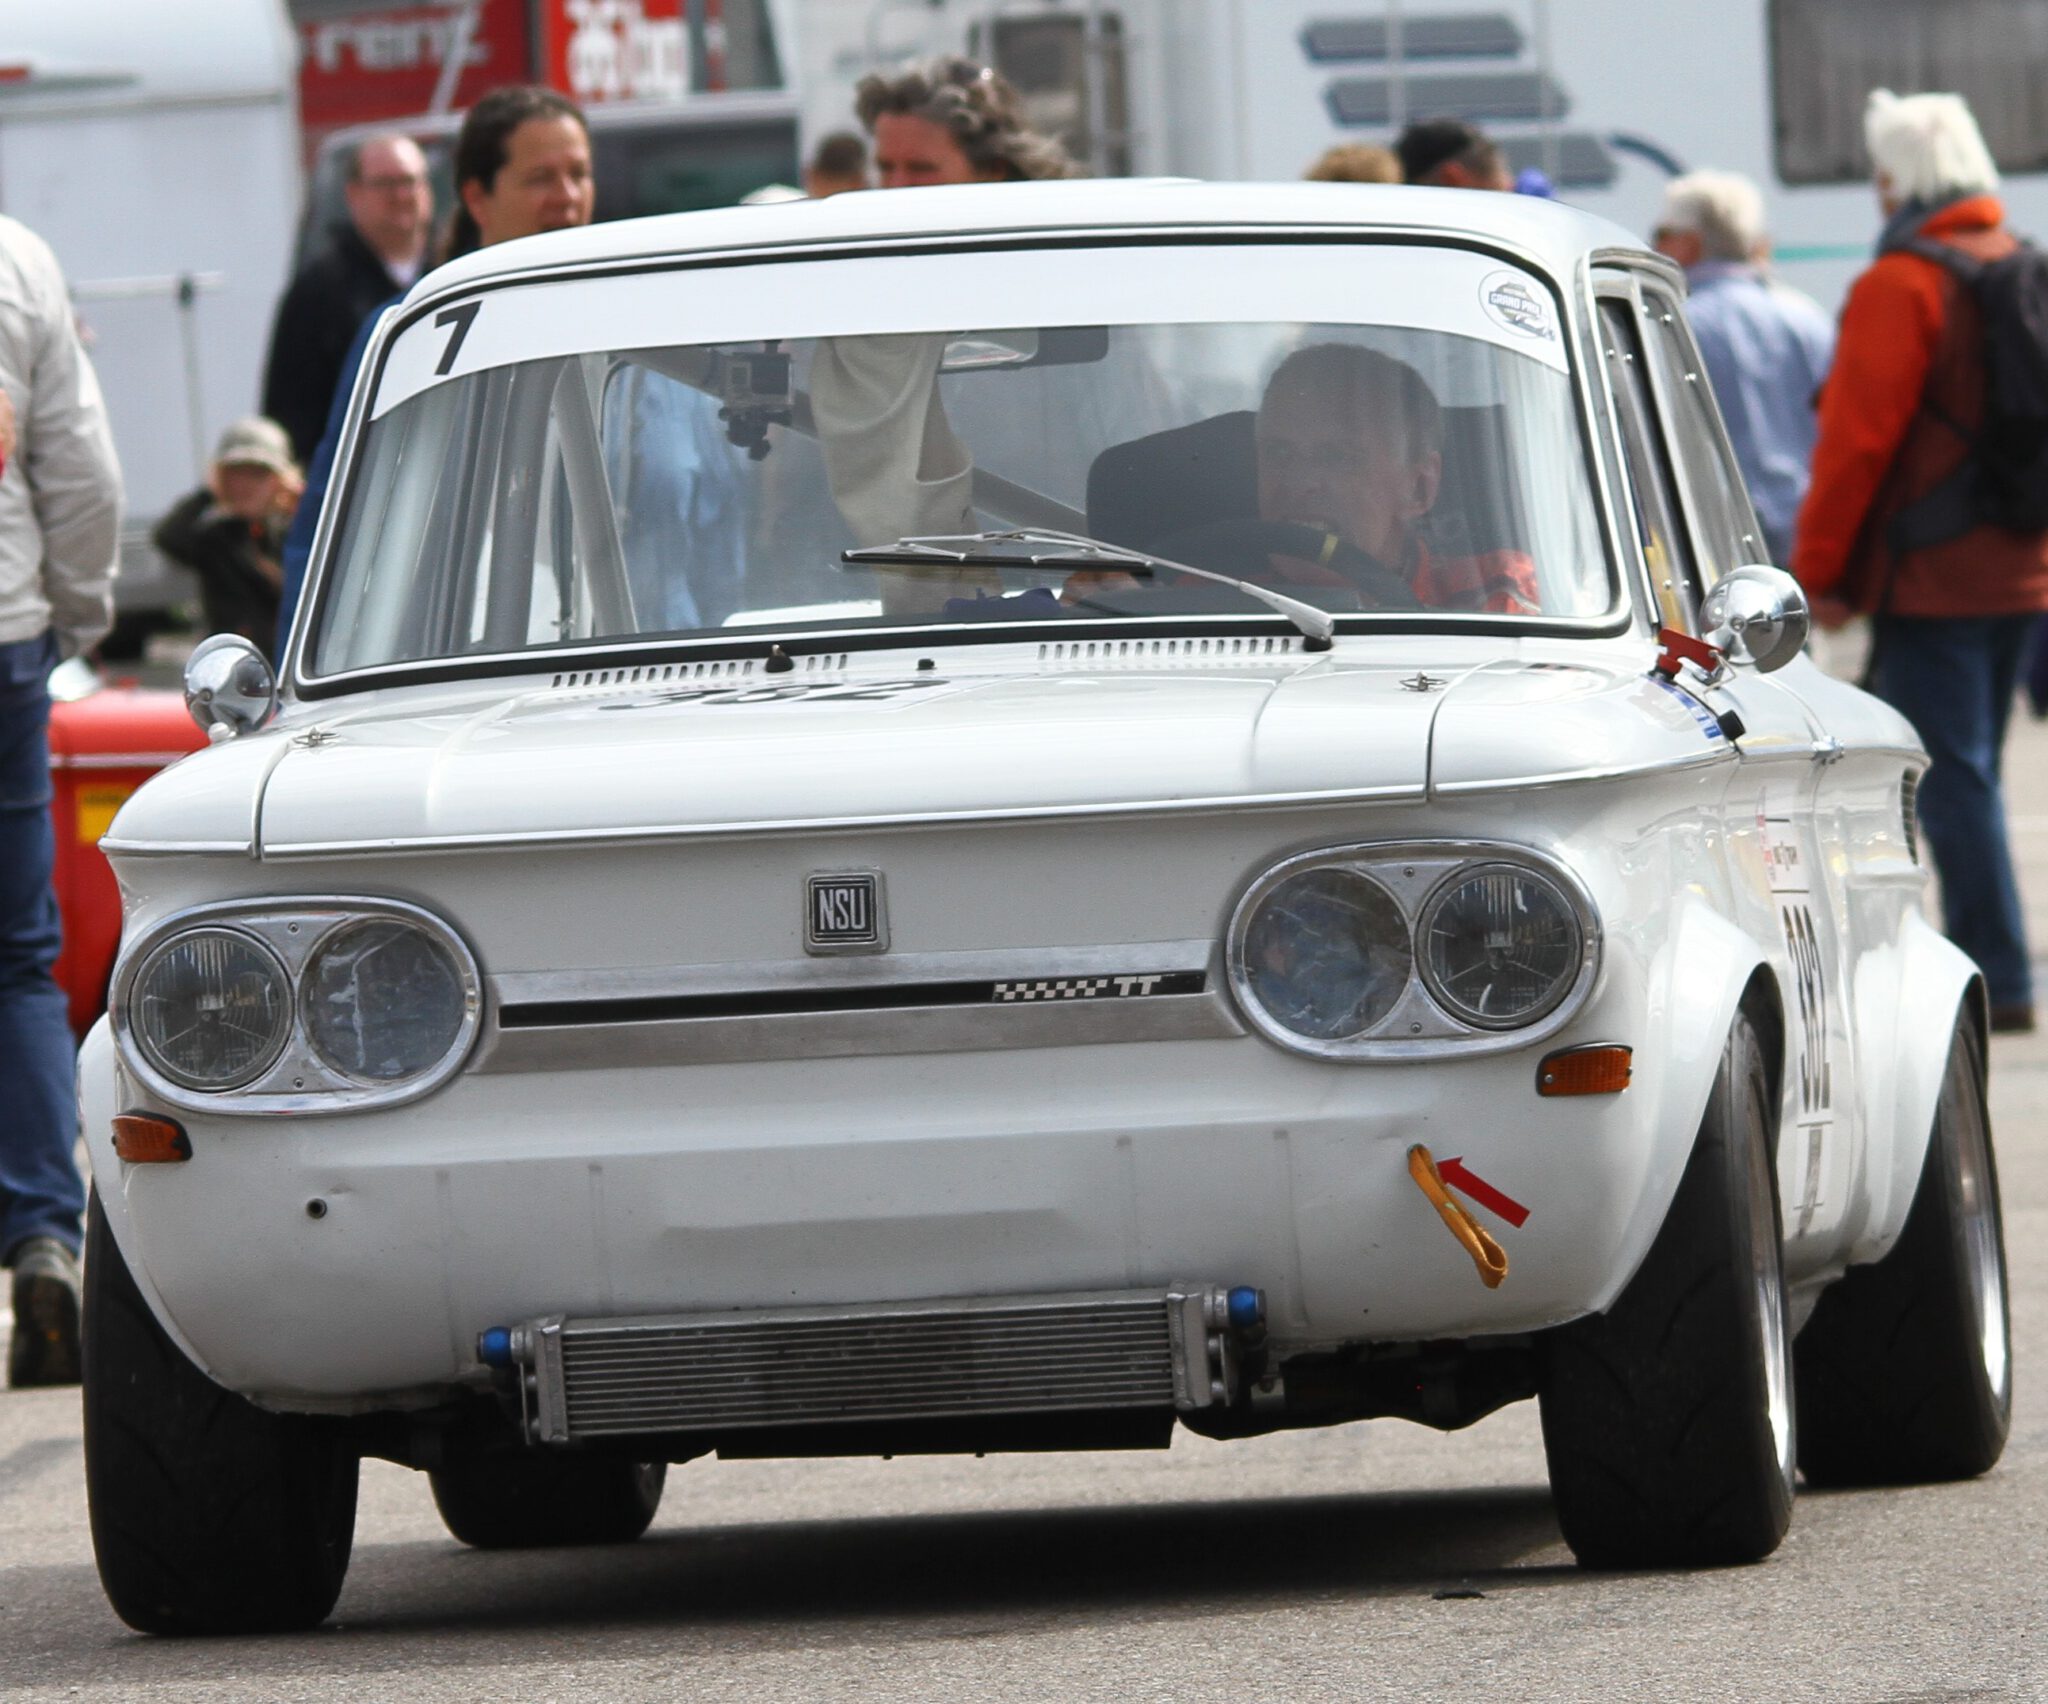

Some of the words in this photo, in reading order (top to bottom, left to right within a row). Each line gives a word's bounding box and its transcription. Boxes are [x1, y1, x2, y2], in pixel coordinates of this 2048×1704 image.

[1491, 293, 1521, 310] GRAND
[434, 301, 482, 376] 7
[818, 887, 867, 931] NSU
[1113, 975, 1162, 997] TT
